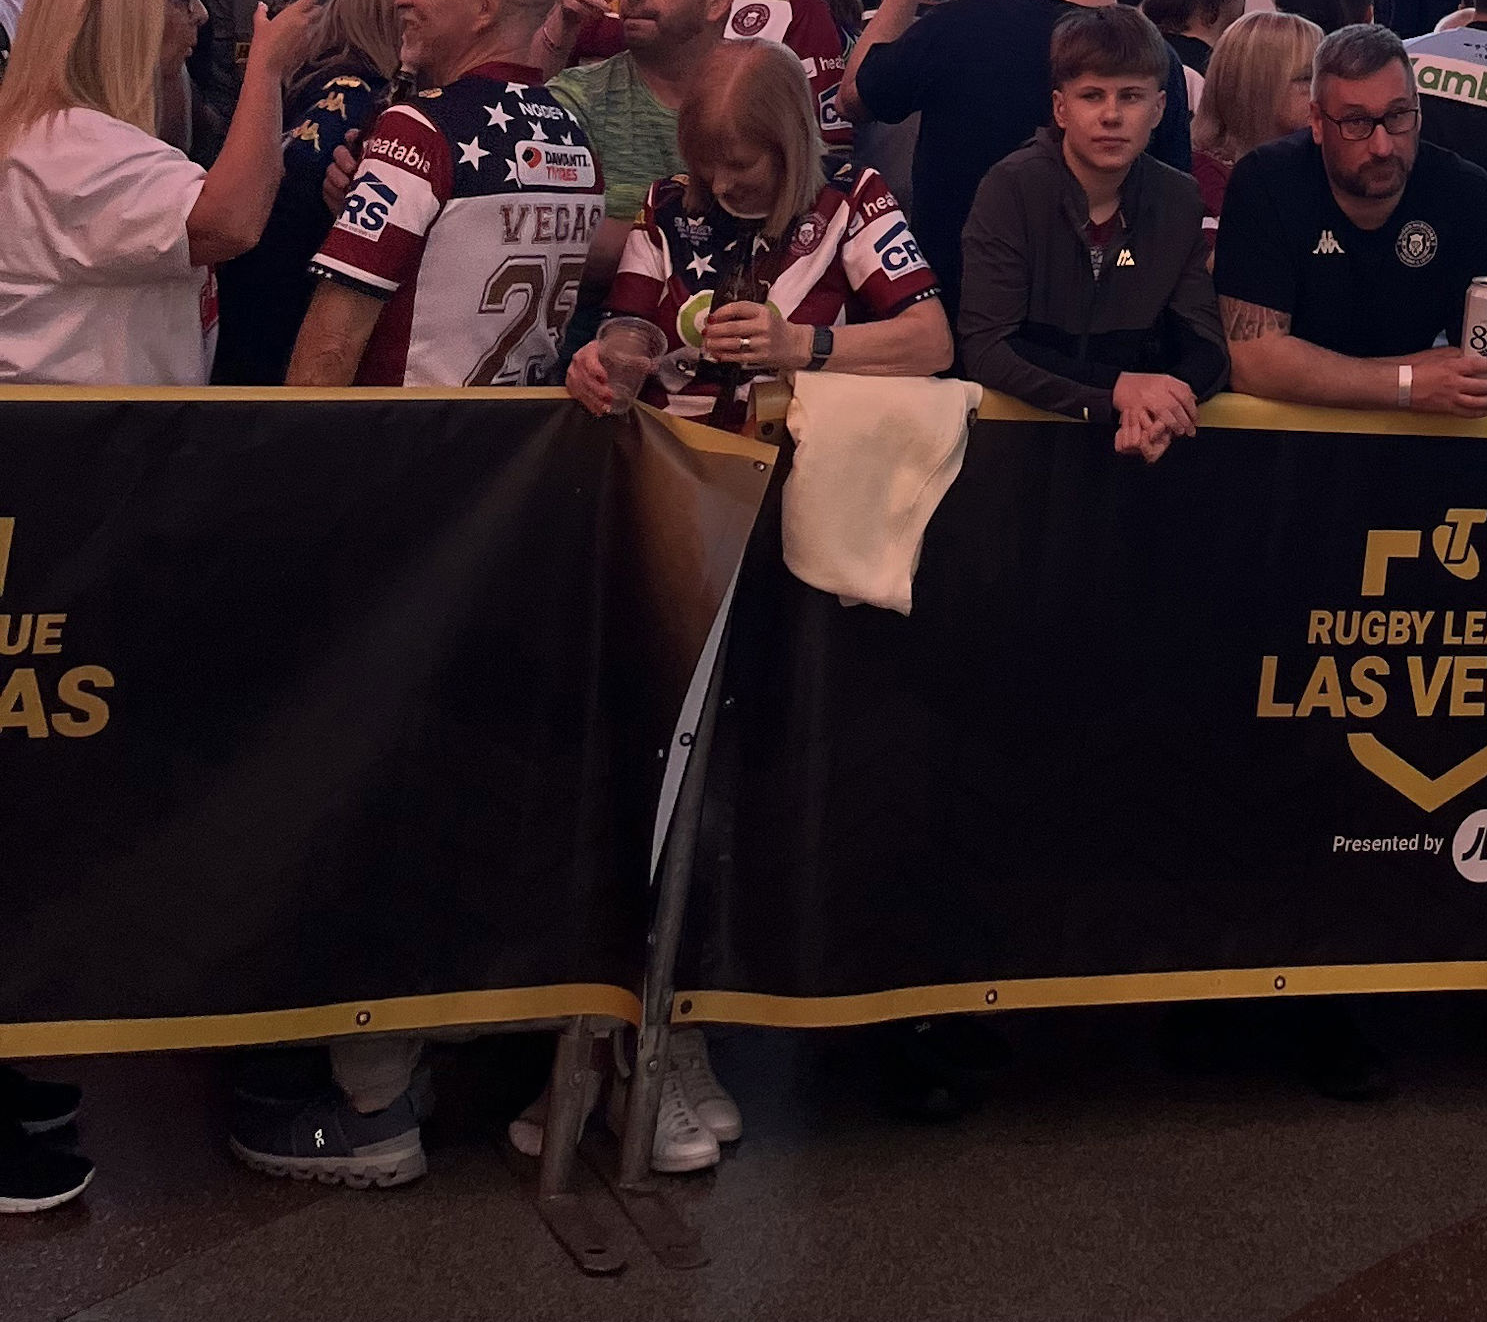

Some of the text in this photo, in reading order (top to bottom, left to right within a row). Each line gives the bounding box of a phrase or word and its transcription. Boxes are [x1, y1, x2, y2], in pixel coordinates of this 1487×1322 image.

[1307, 609, 1435, 646] RUGBY
[1257, 655, 1390, 718] LAS
[1332, 834, 1419, 853] Presented
[1424, 834, 1444, 855] by
